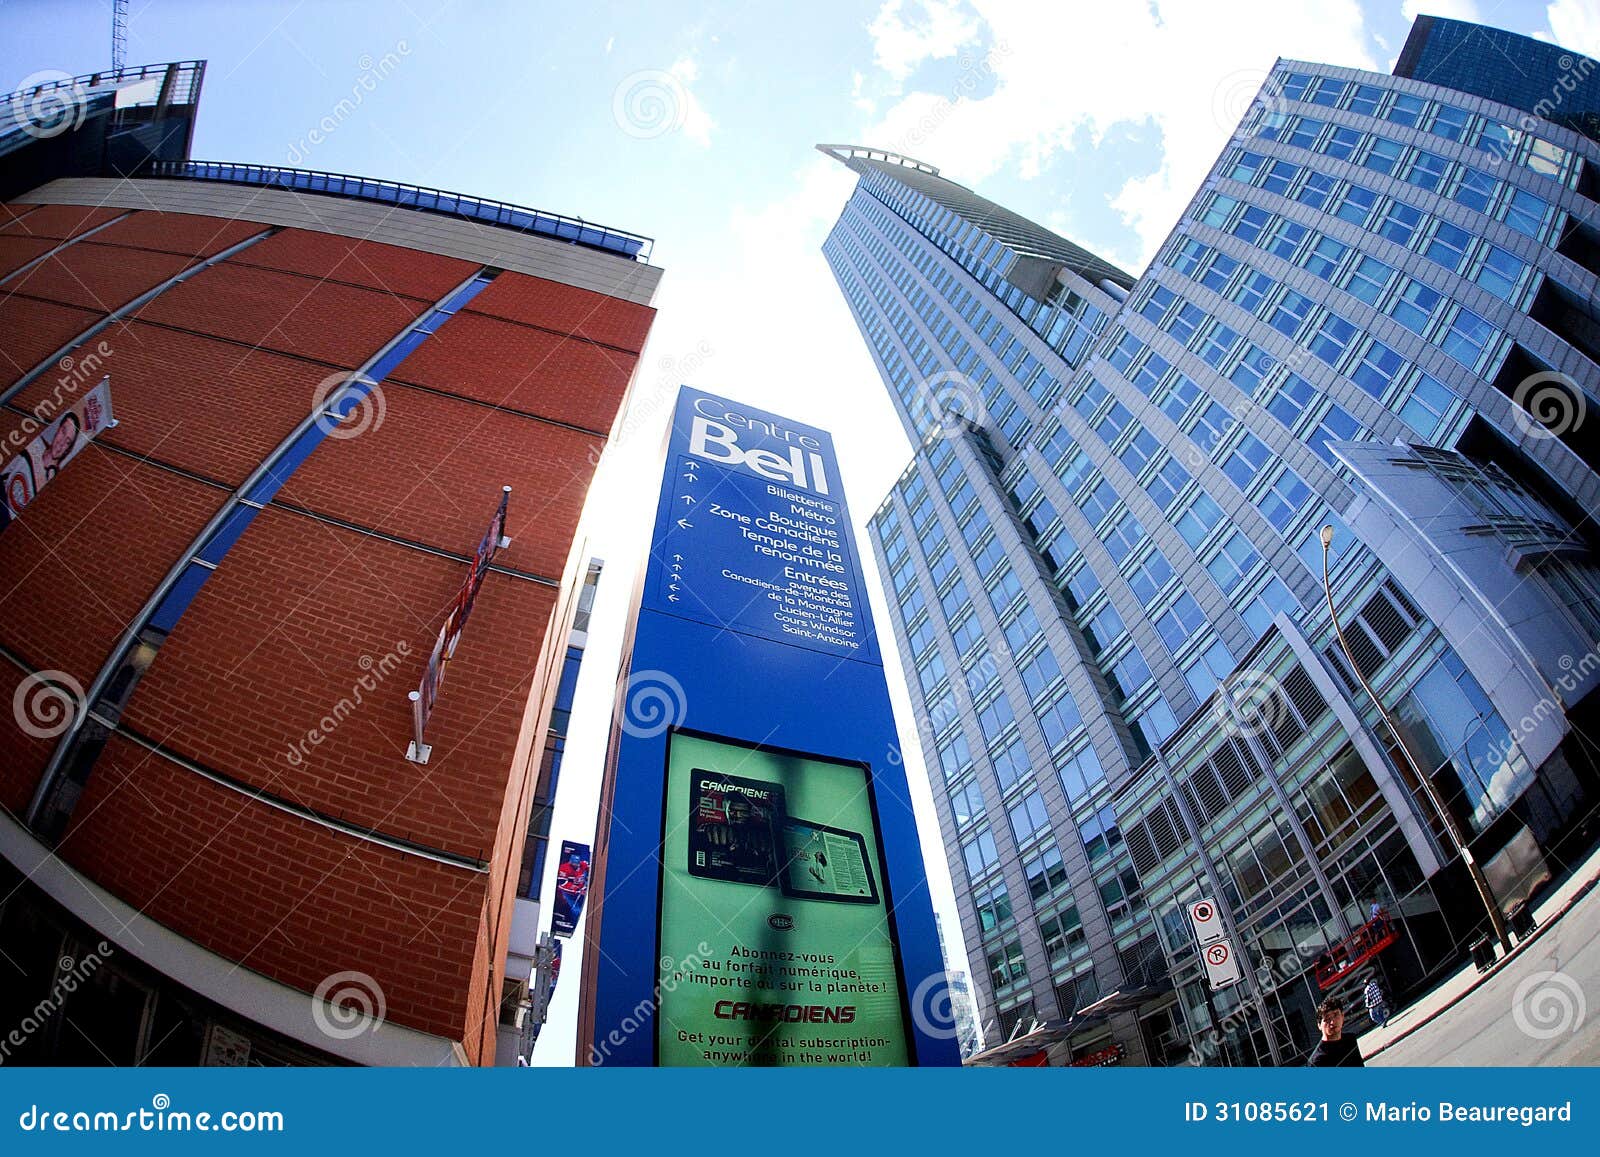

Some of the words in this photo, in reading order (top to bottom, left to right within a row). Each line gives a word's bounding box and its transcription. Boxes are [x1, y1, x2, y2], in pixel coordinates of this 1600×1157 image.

[694, 398, 820, 451] Centre
[690, 416, 829, 495] Bell
[767, 484, 833, 512] Billetterie
[709, 503, 751, 524] Zone
[755, 517, 840, 548] Canadiens
[770, 511, 837, 538] Boutique
[790, 504, 836, 525] Métro
[739, 525, 797, 551] Temple
[802, 544, 823, 558] de
[827, 549, 842, 562] la
[755, 544, 845, 574] renommée
[722, 569, 852, 608] Canadiens-de-Montréal
[784, 566, 848, 591] Entrées
[789, 582, 828, 596] avenue
[830, 590, 849, 601] des
[767, 592, 782, 602] de
[785, 595, 795, 605] la
[798, 599, 853, 618] Montagne
[779, 603, 855, 628] Lucien-L'Allier
[774, 612, 808, 627] Cours
[810, 620, 857, 638] Windsor
[783, 623, 860, 649] Saint-Antoine
[731, 945, 834, 964] Abonnez-vous
[674, 970, 751, 988] n'importe
[780, 980, 803, 991] sur
[809, 979, 823, 992] la
[703, 960, 721, 970] au
[726, 959, 774, 974] forfait
[779, 965, 861, 981] numérique,
[713, 1000, 857, 1024] CANADIENS
[677, 1030, 704, 1044] Get
[708, 1034, 743, 1046] your
[799, 1036, 891, 1050] subscription-
[782, 1051, 795, 1064] in
[799, 1050, 823, 1064] the
[826, 1051, 872, 1063] world!
